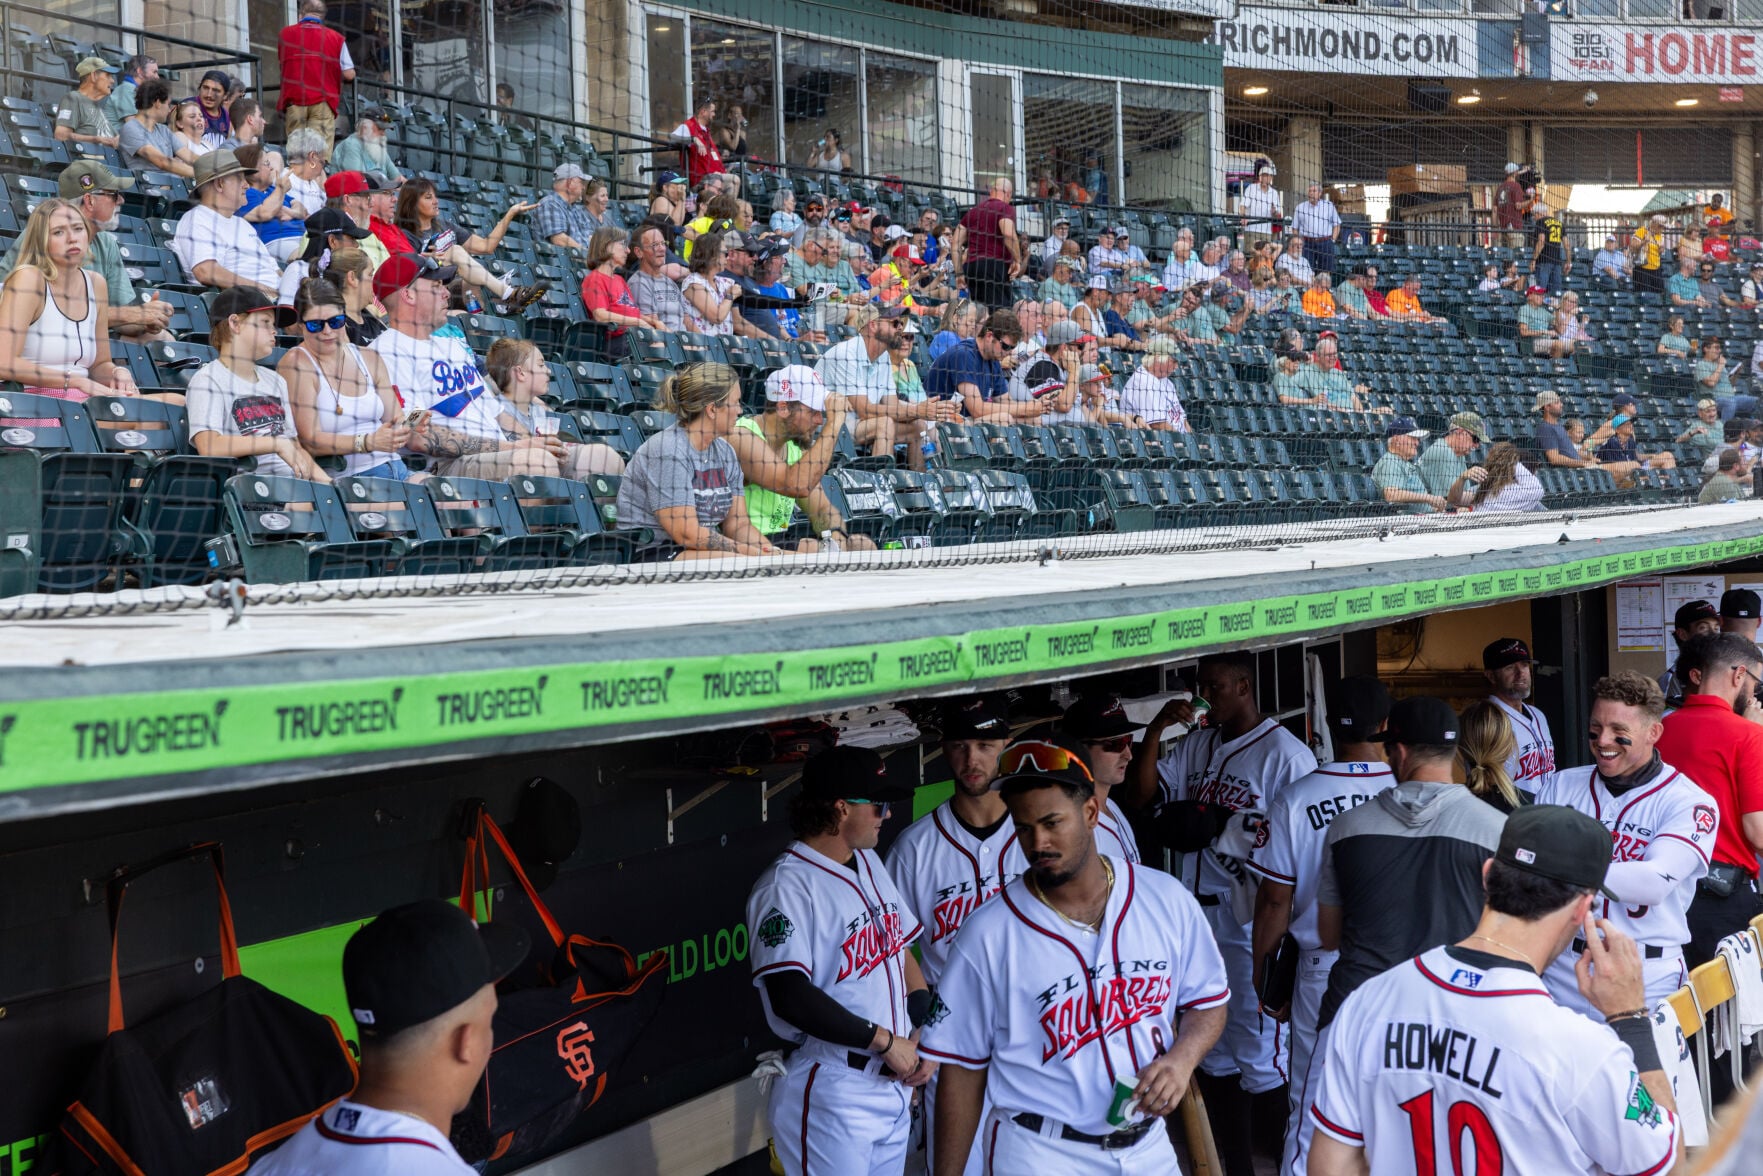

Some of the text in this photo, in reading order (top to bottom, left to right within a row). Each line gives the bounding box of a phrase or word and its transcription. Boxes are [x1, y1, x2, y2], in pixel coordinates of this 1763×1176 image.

[1573, 33, 1602, 45] 910
[1625, 32, 1756, 76] HOME
[1549, 225, 1563, 243] 21
[1307, 600, 1337, 621] TRUGREEN
[1345, 597, 1374, 613] TRUGREEN
[1381, 593, 1407, 611] TRUGREEN
[1413, 589, 1438, 605] TRUGREEN
[1167, 617, 1207, 642] TRUGREEN
[1218, 611, 1255, 634] TRUGREEN
[1264, 606, 1298, 628] TRUGREEN
[1047, 630, 1095, 660] TRUGREEN
[1111, 624, 1152, 650] TRUGREEN
[899, 648, 959, 680] TRUGREEN
[975, 639, 1029, 668] TRUGREEN
[702, 665, 781, 700] TRUGREEN
[808, 658, 875, 692] TRUGREEN
[436, 688, 544, 727] TRUGREEN
[580, 675, 669, 711] TRUGREEN
[73, 713, 222, 761] TRUGREEN
[276, 700, 396, 743] TRUGREEN
[1037, 959, 1168, 1012] FLYING
[1040, 975, 1171, 1066] SQUIRRELS
[1384, 1022, 1503, 1099] HOWELL
[1398, 1088, 1504, 1176] 10
